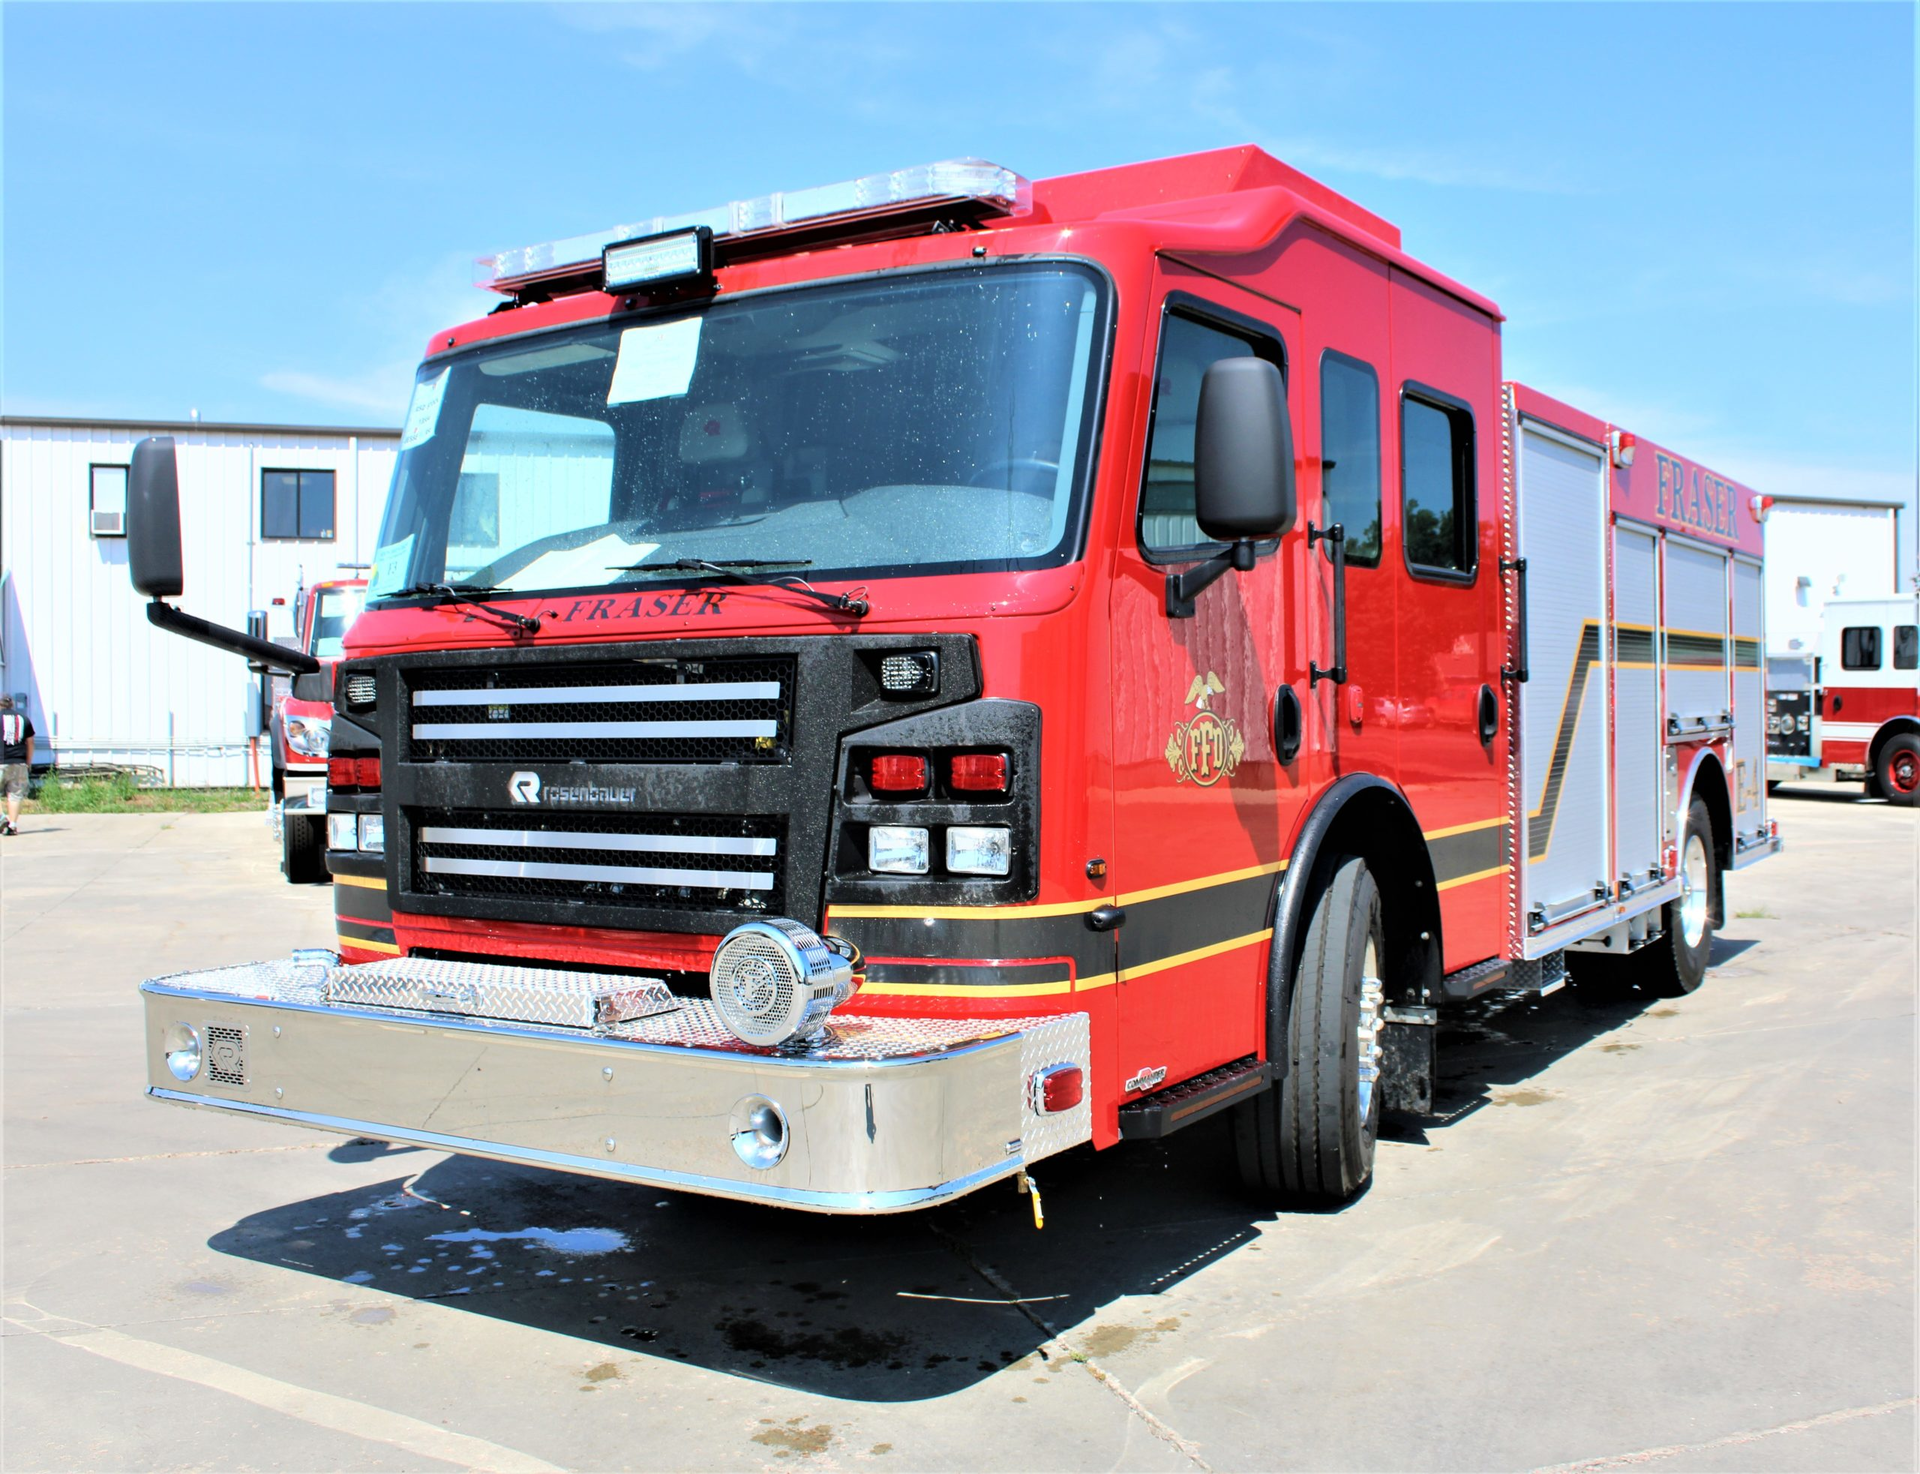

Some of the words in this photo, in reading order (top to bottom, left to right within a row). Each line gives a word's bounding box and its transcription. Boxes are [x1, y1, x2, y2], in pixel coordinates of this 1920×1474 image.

[1655, 450, 1739, 543] FRASER
[562, 592, 727, 622] FRASER
[1190, 720, 1223, 778] FFD
[543, 781, 636, 803] rosenbauer
